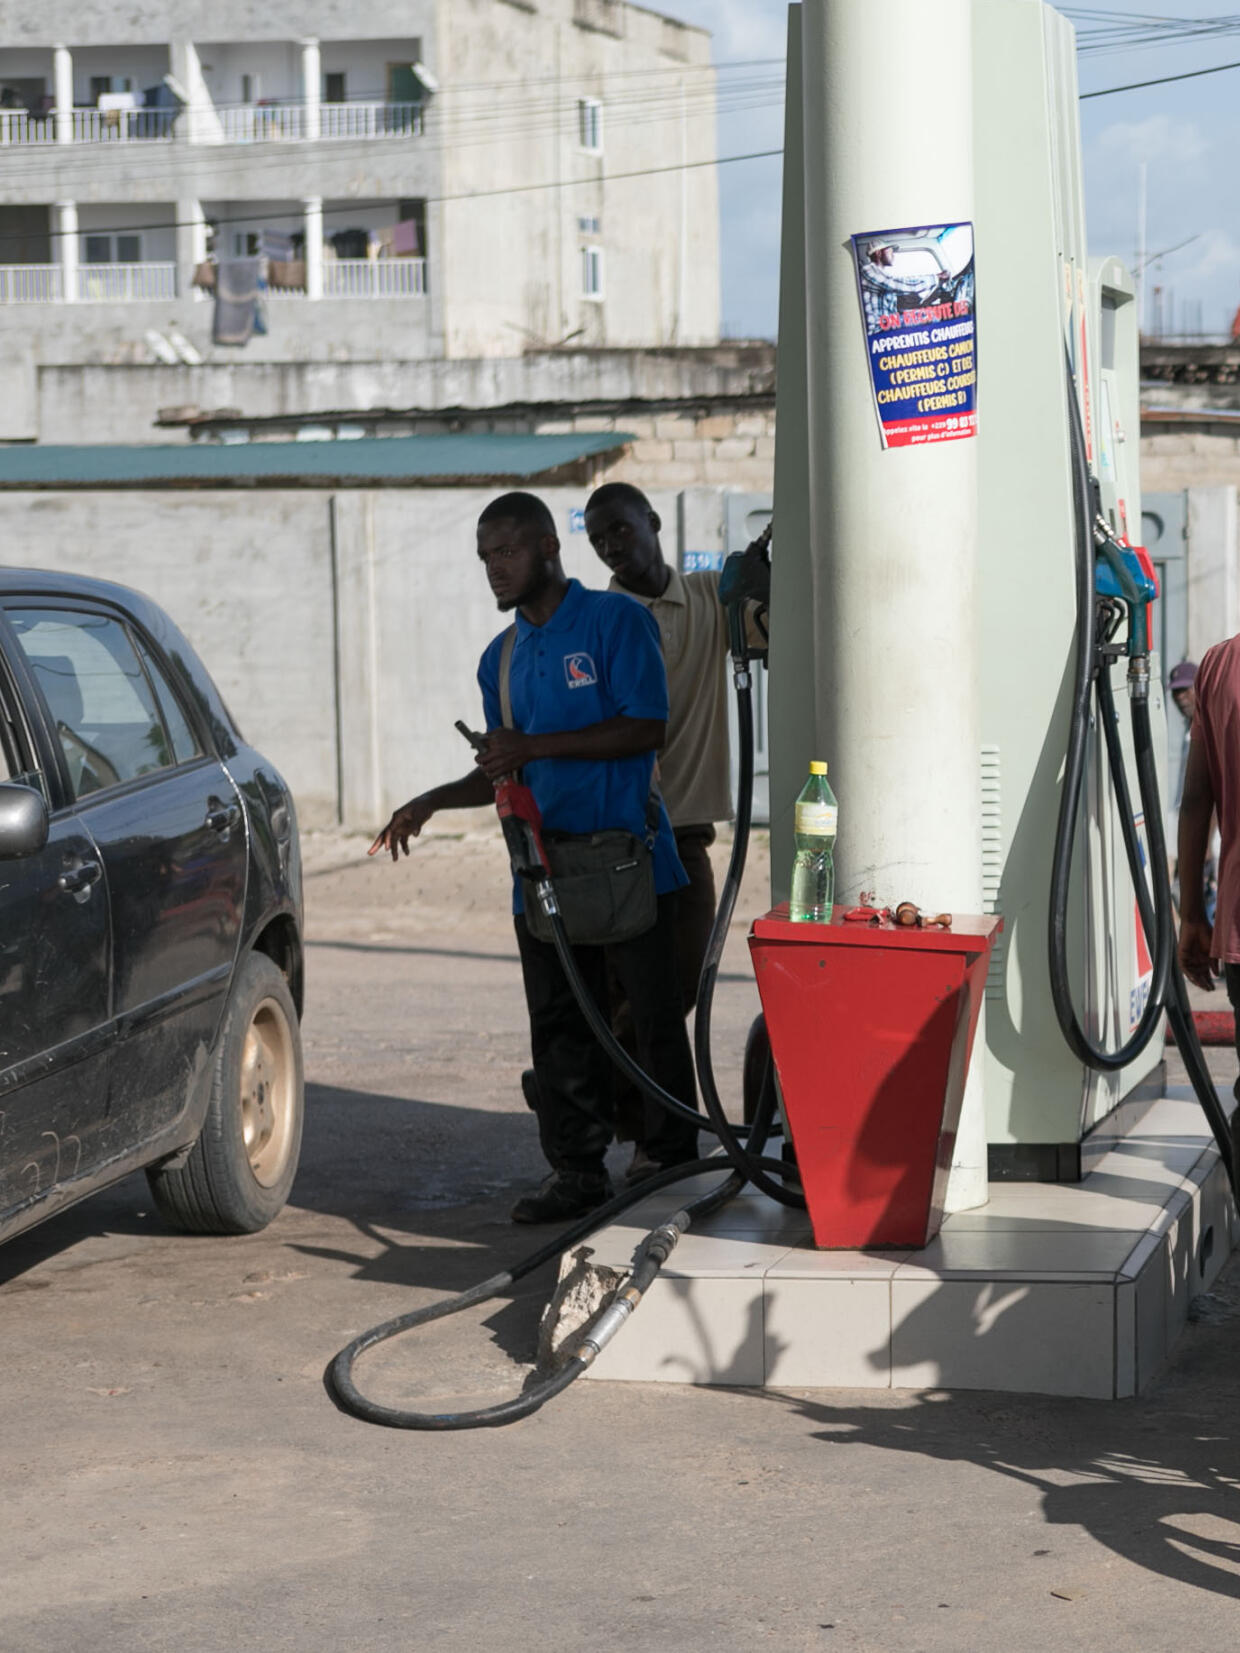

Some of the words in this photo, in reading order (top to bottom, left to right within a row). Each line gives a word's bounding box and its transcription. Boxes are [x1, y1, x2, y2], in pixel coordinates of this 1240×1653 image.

[879, 312, 900, 331] ON
[872, 330, 930, 354] APPRENTIS
[879, 346, 948, 371] CHAUFFEURS
[937, 363, 950, 377] C)
[952, 358, 962, 373] ET
[877, 379, 946, 404] CHAUFFEURS
